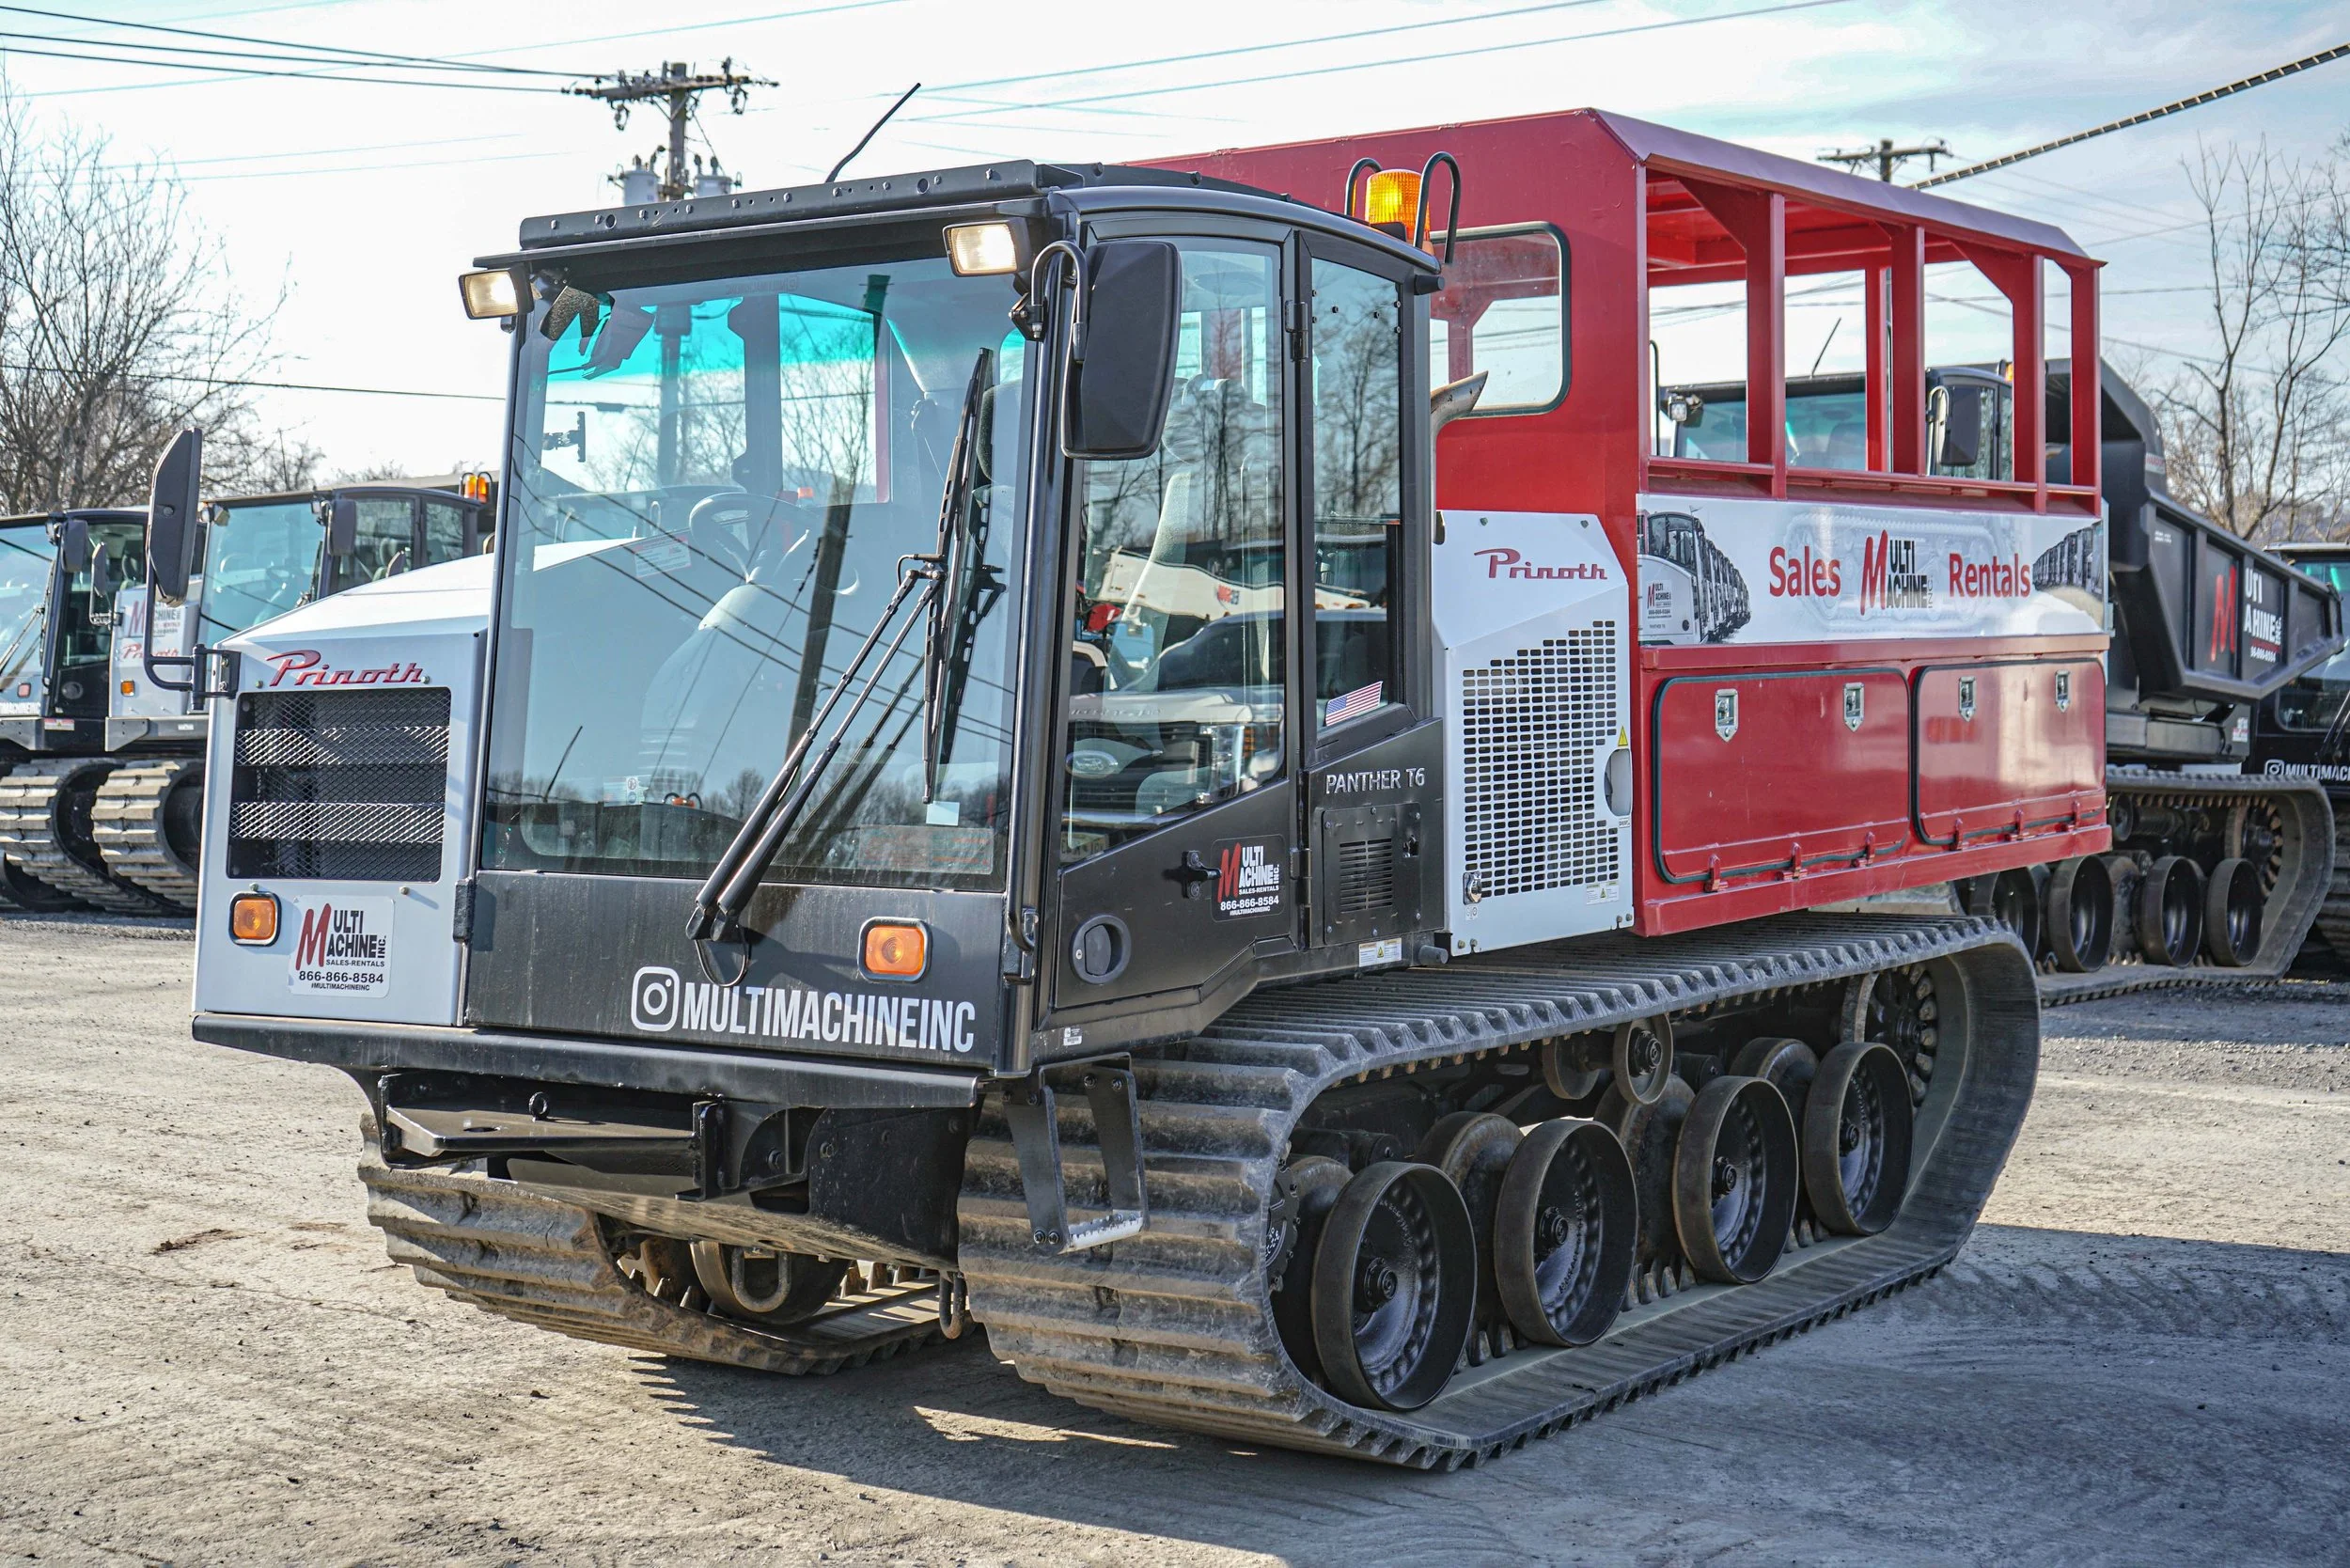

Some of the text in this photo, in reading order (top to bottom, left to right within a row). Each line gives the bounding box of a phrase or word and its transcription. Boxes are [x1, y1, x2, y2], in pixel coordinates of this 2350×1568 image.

[1473, 547, 1608, 580] Prinoth
[1769, 545, 1841, 597] Sales
[1949, 552, 2031, 598] Rentals
[264, 649, 424, 687] Prinoth
[1325, 767, 1425, 794] PANTHER T6
[1220, 895, 1279, 911] 866-866-8584
[1239, 885, 1279, 895] SALES-RENTALS
[299, 970, 384, 984] 866-866-8584
[325, 959, 385, 967] SALES-RENTALS
[682, 981, 976, 1054] MULTIMACHINEINC
